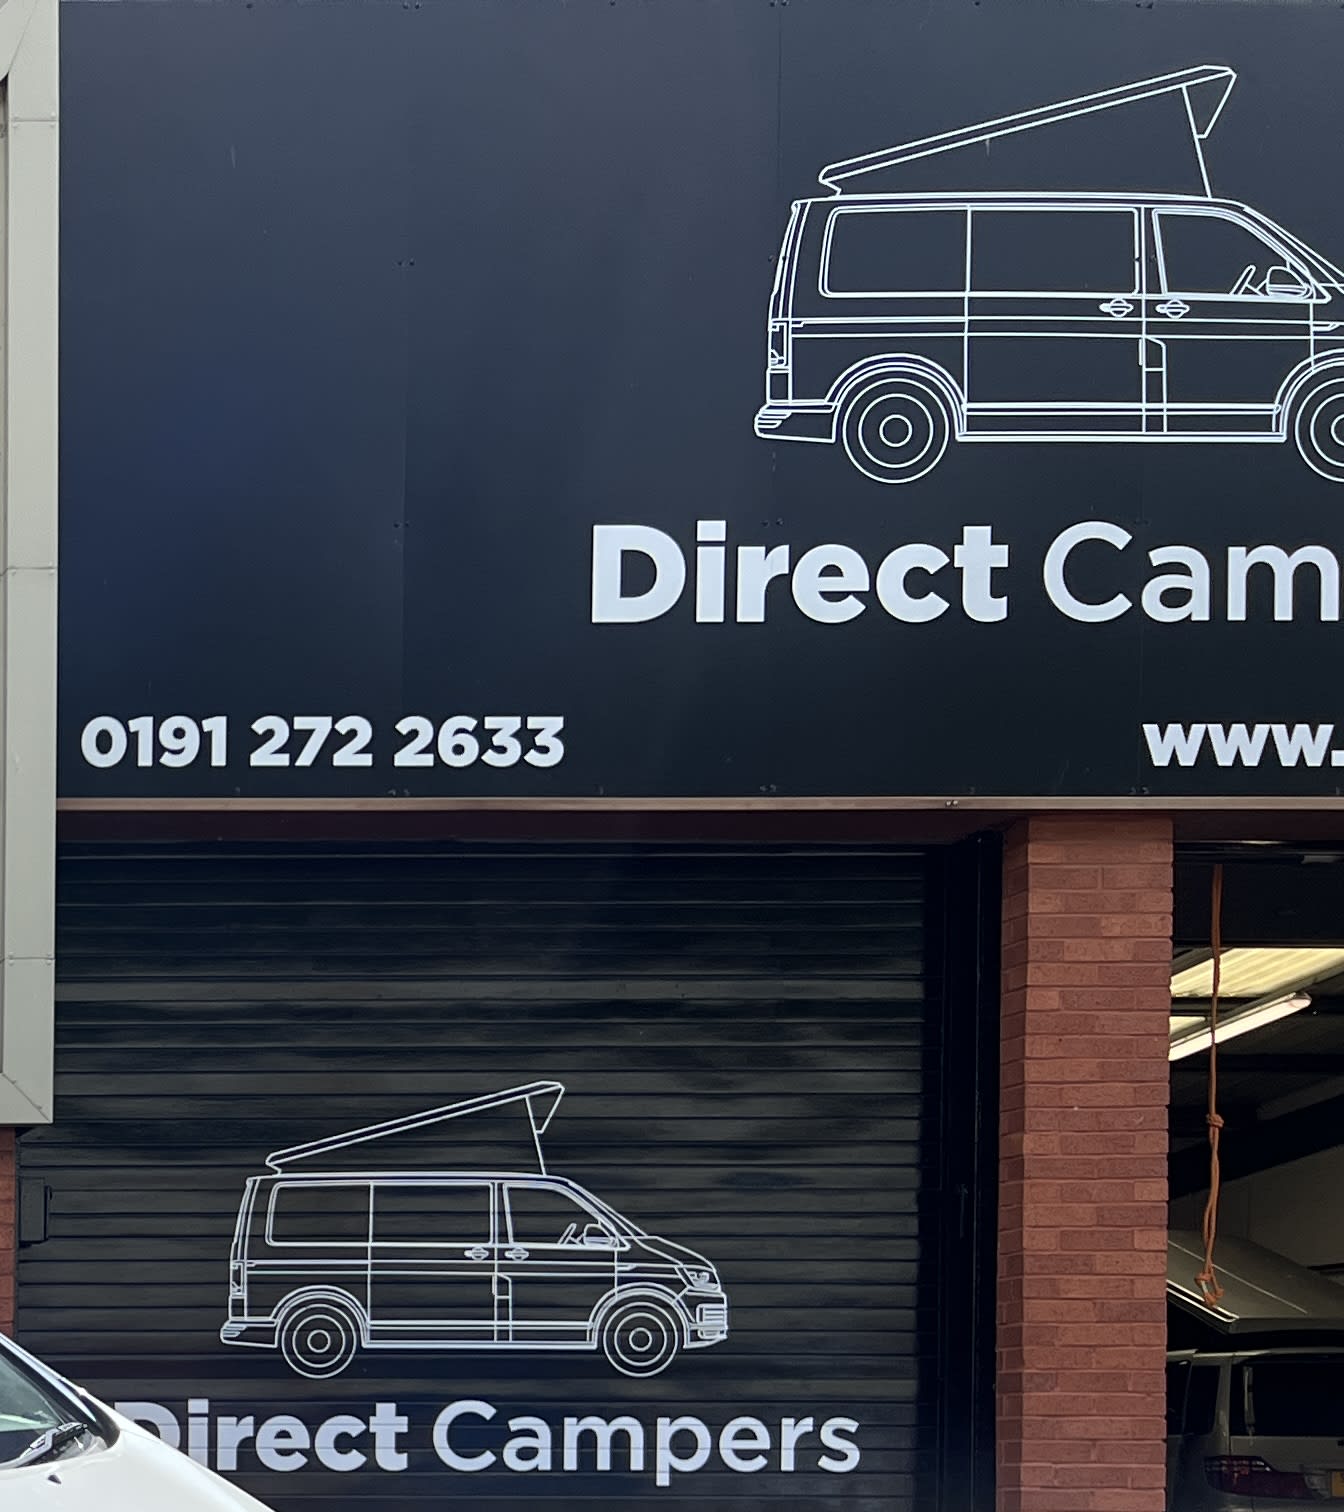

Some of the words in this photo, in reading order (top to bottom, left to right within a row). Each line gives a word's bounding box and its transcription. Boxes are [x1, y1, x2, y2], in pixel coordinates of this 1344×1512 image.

[591, 519, 1009, 624] Direct
[1043, 520, 1341, 624] Cam
[80, 715, 227, 768] 0191
[249, 715, 373, 768] 272
[393, 715, 565, 768] 2633
[1142, 723, 1344, 767] www.
[432, 1399, 861, 1487] Campers
